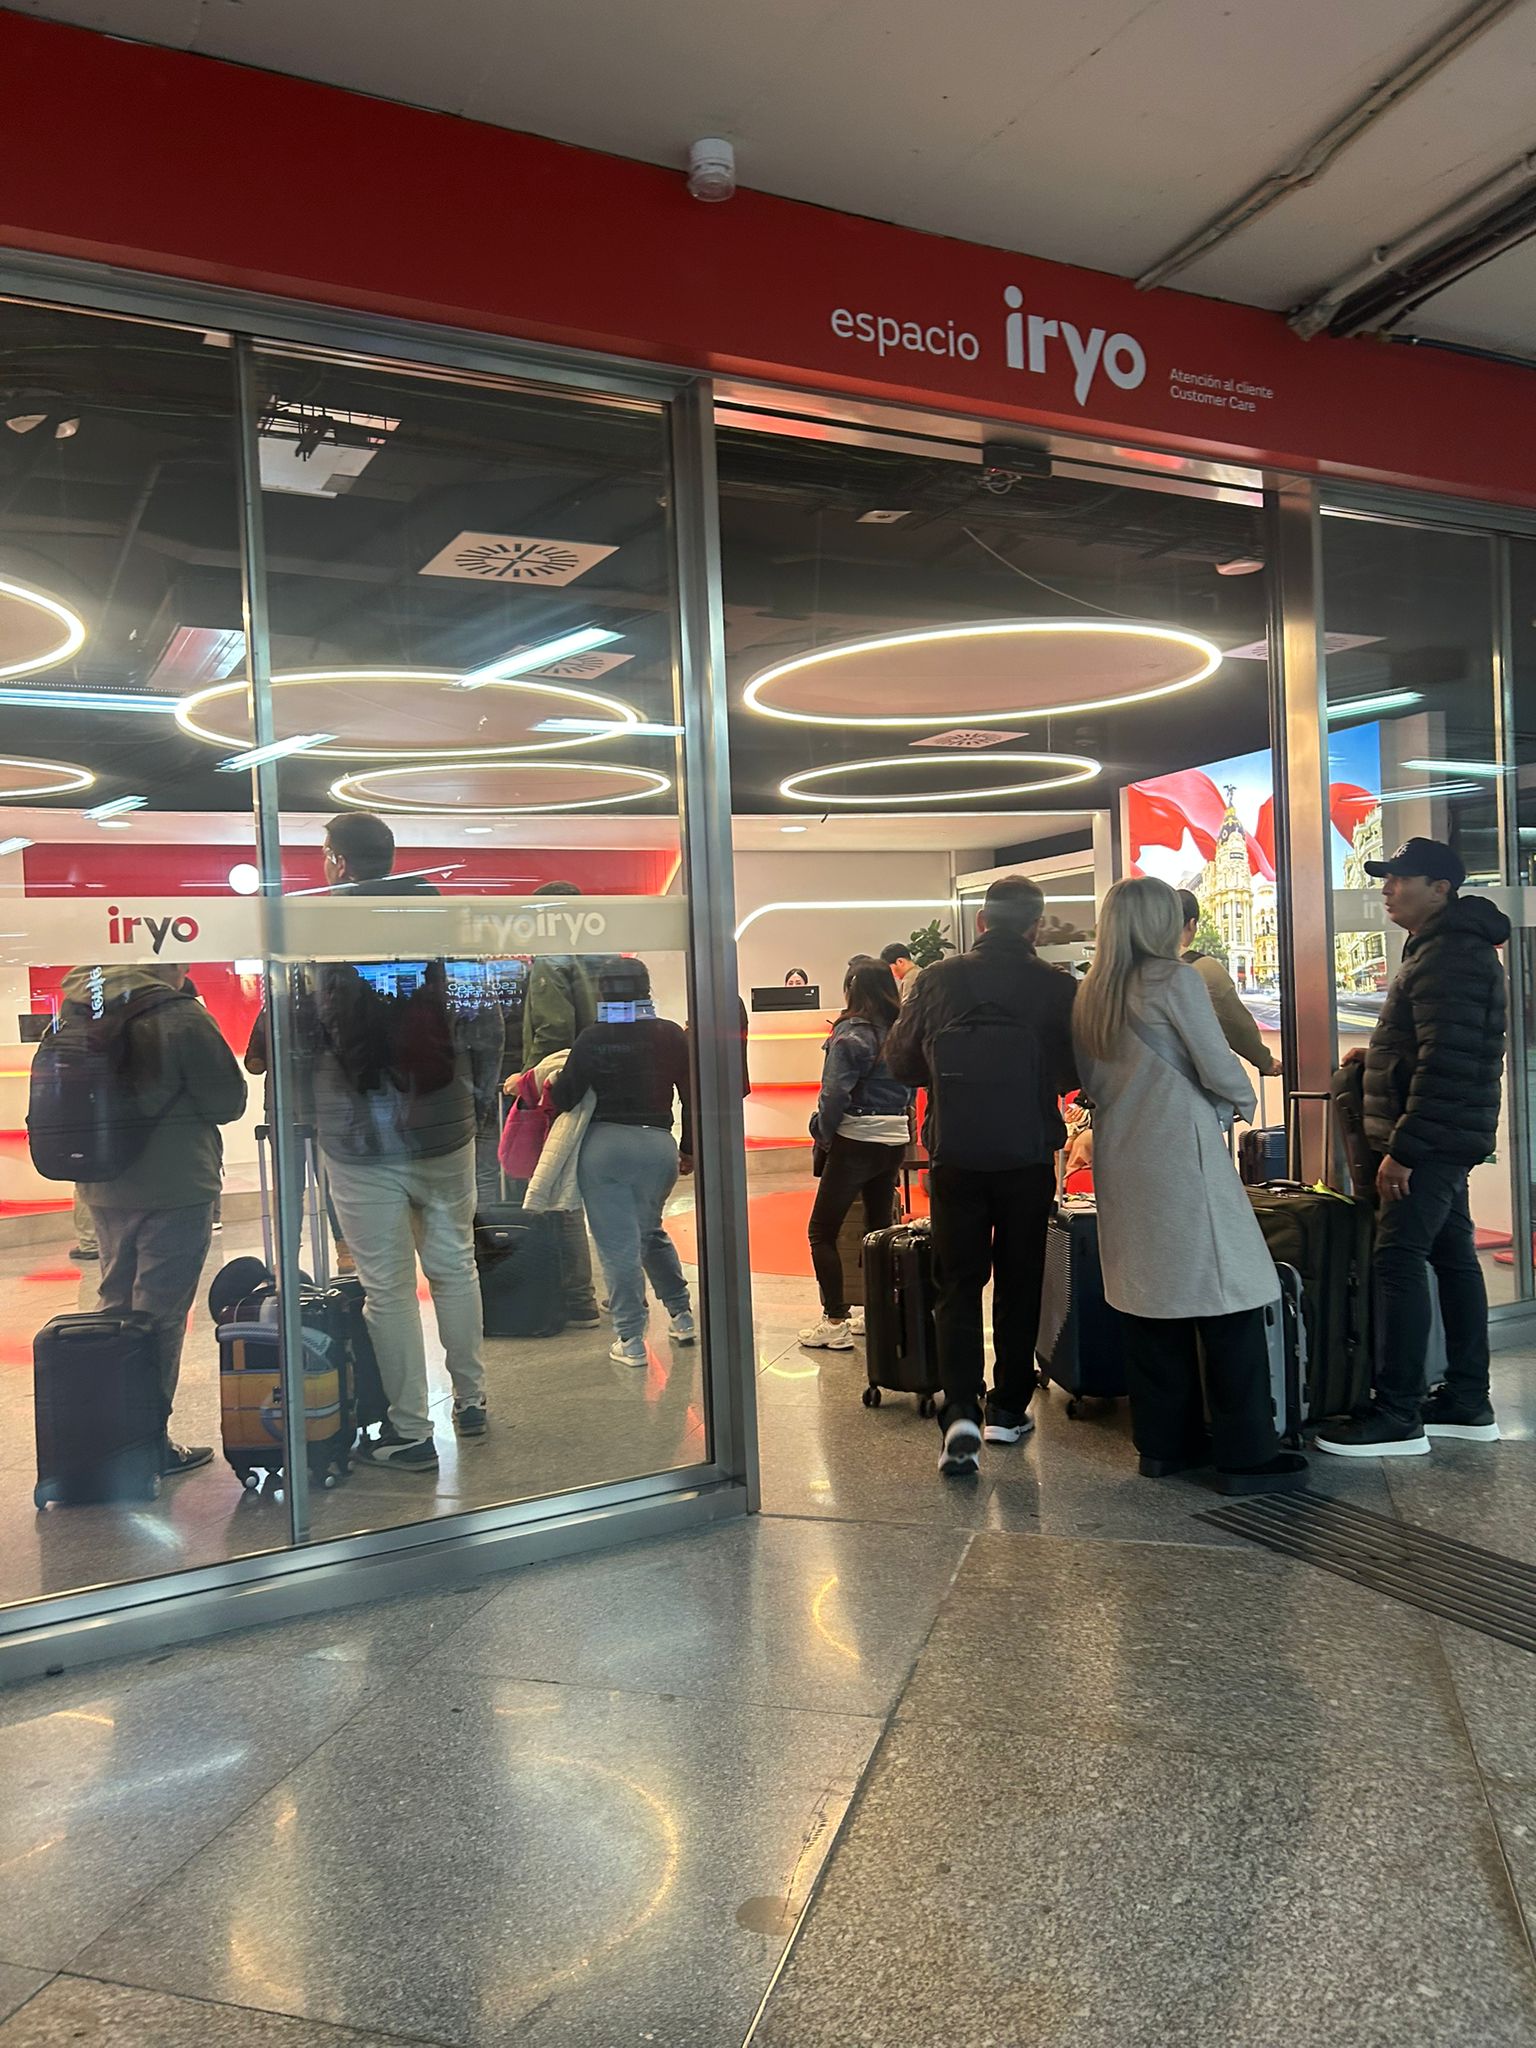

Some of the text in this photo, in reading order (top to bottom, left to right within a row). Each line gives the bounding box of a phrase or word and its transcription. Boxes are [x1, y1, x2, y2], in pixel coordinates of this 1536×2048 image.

[831, 285, 1147, 407] espacio iryo
[1170, 368, 1274, 399] Atención al cliente
[1170, 385, 1256, 412] Customer Care
[107, 905, 199, 955] iryo
[461, 904, 536, 951] iryo
[536, 908, 606, 945] iryo
